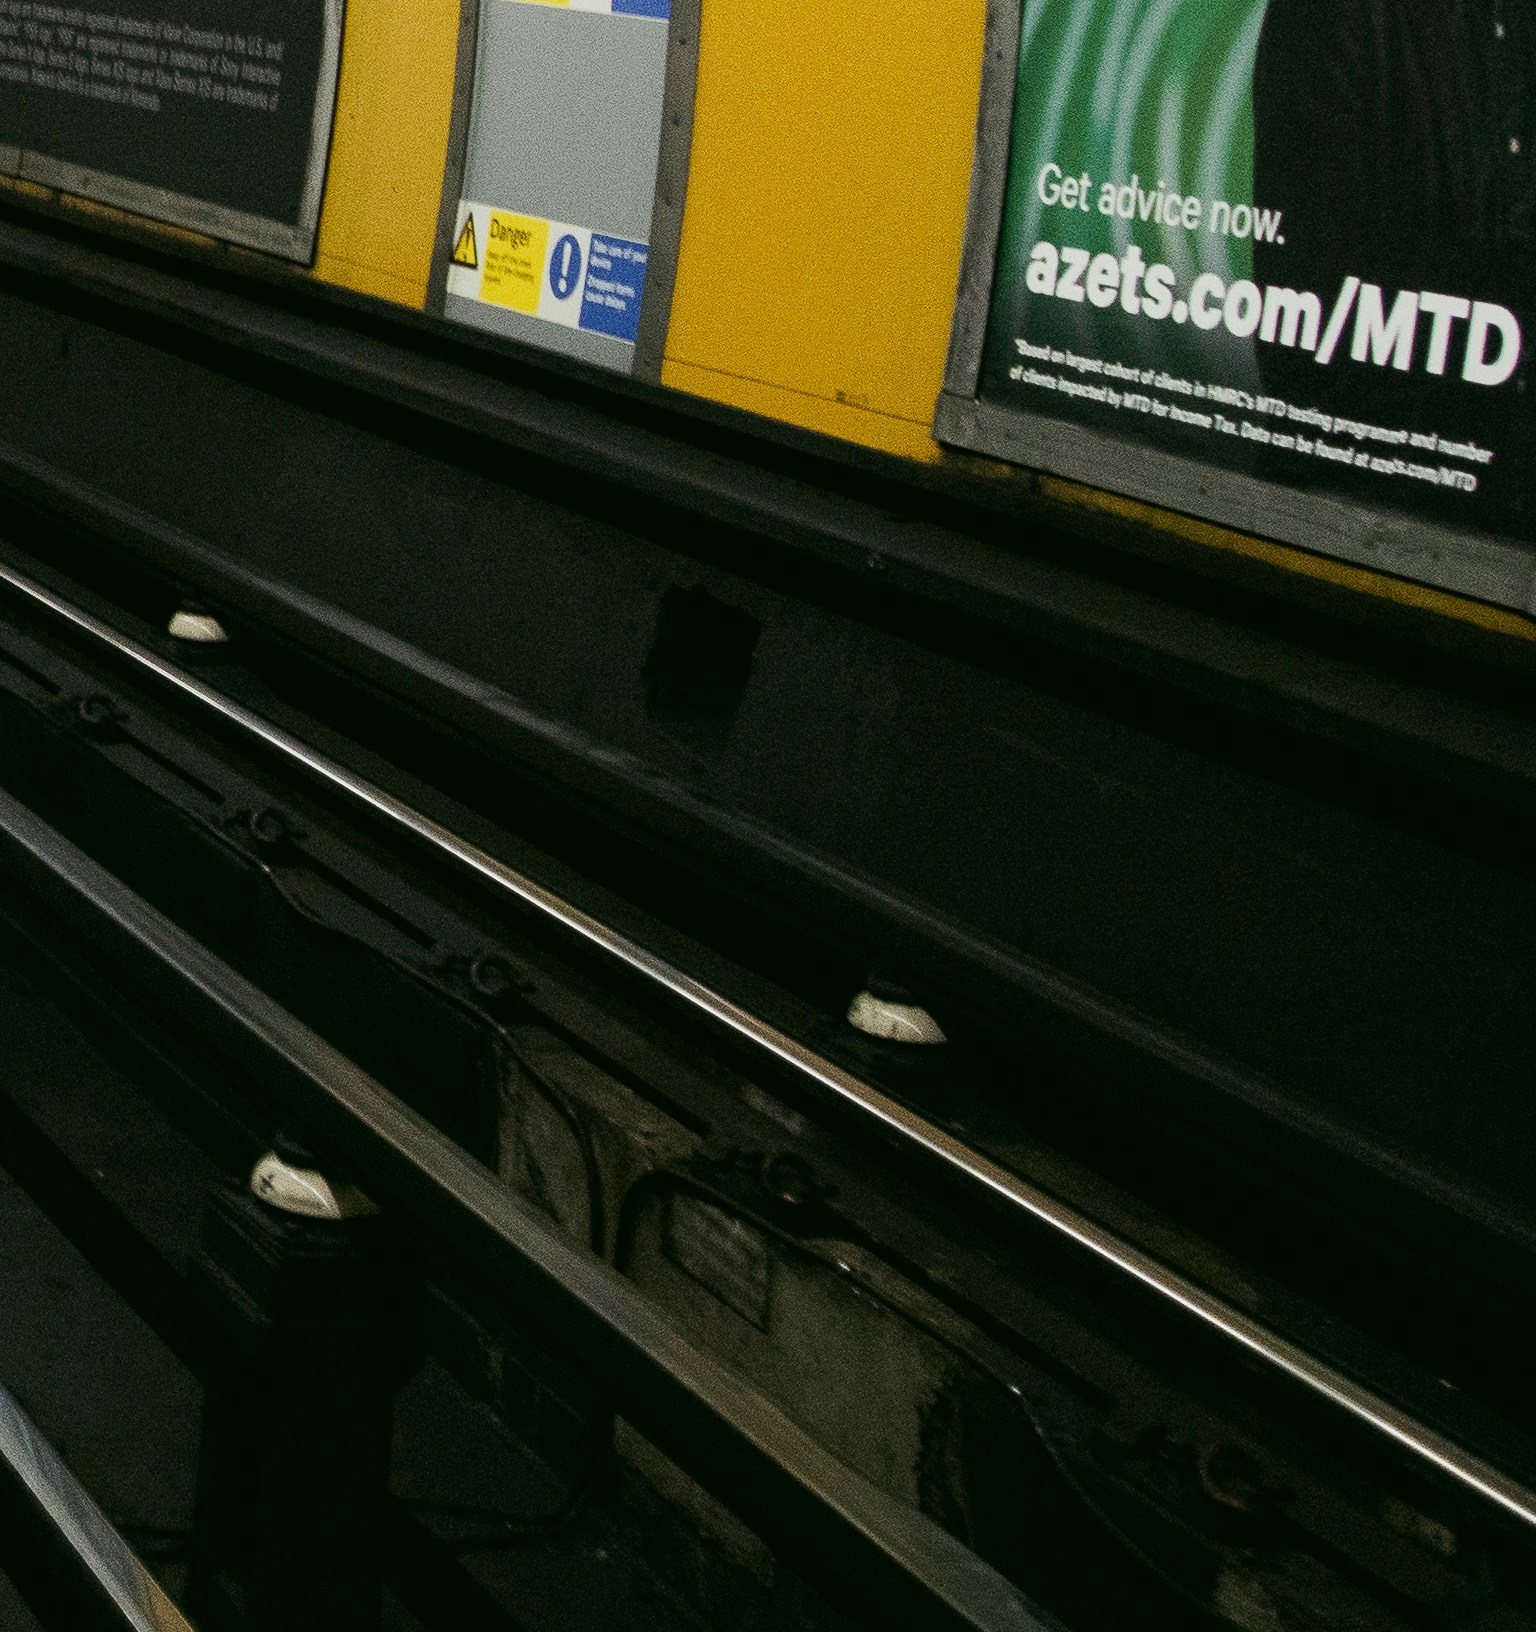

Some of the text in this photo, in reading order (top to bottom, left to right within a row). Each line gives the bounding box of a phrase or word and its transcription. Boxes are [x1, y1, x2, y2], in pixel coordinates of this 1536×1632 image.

[491, 218, 532, 250] Danger
[1038, 162, 1286, 245] Get advice now.
[1026, 240, 1522, 387] azets.com/MTD
[1050, 350, 1066, 363] on
[1066, 349, 1103, 374] largest
[1140, 369, 1155, 386] of
[1154, 372, 1193, 395] clients
[1255, 395, 1287, 417] MTD
[1408, 432, 1438, 451] and
[1123, 392, 1152, 413] MTD
[1314, 439, 1355, 465] found
